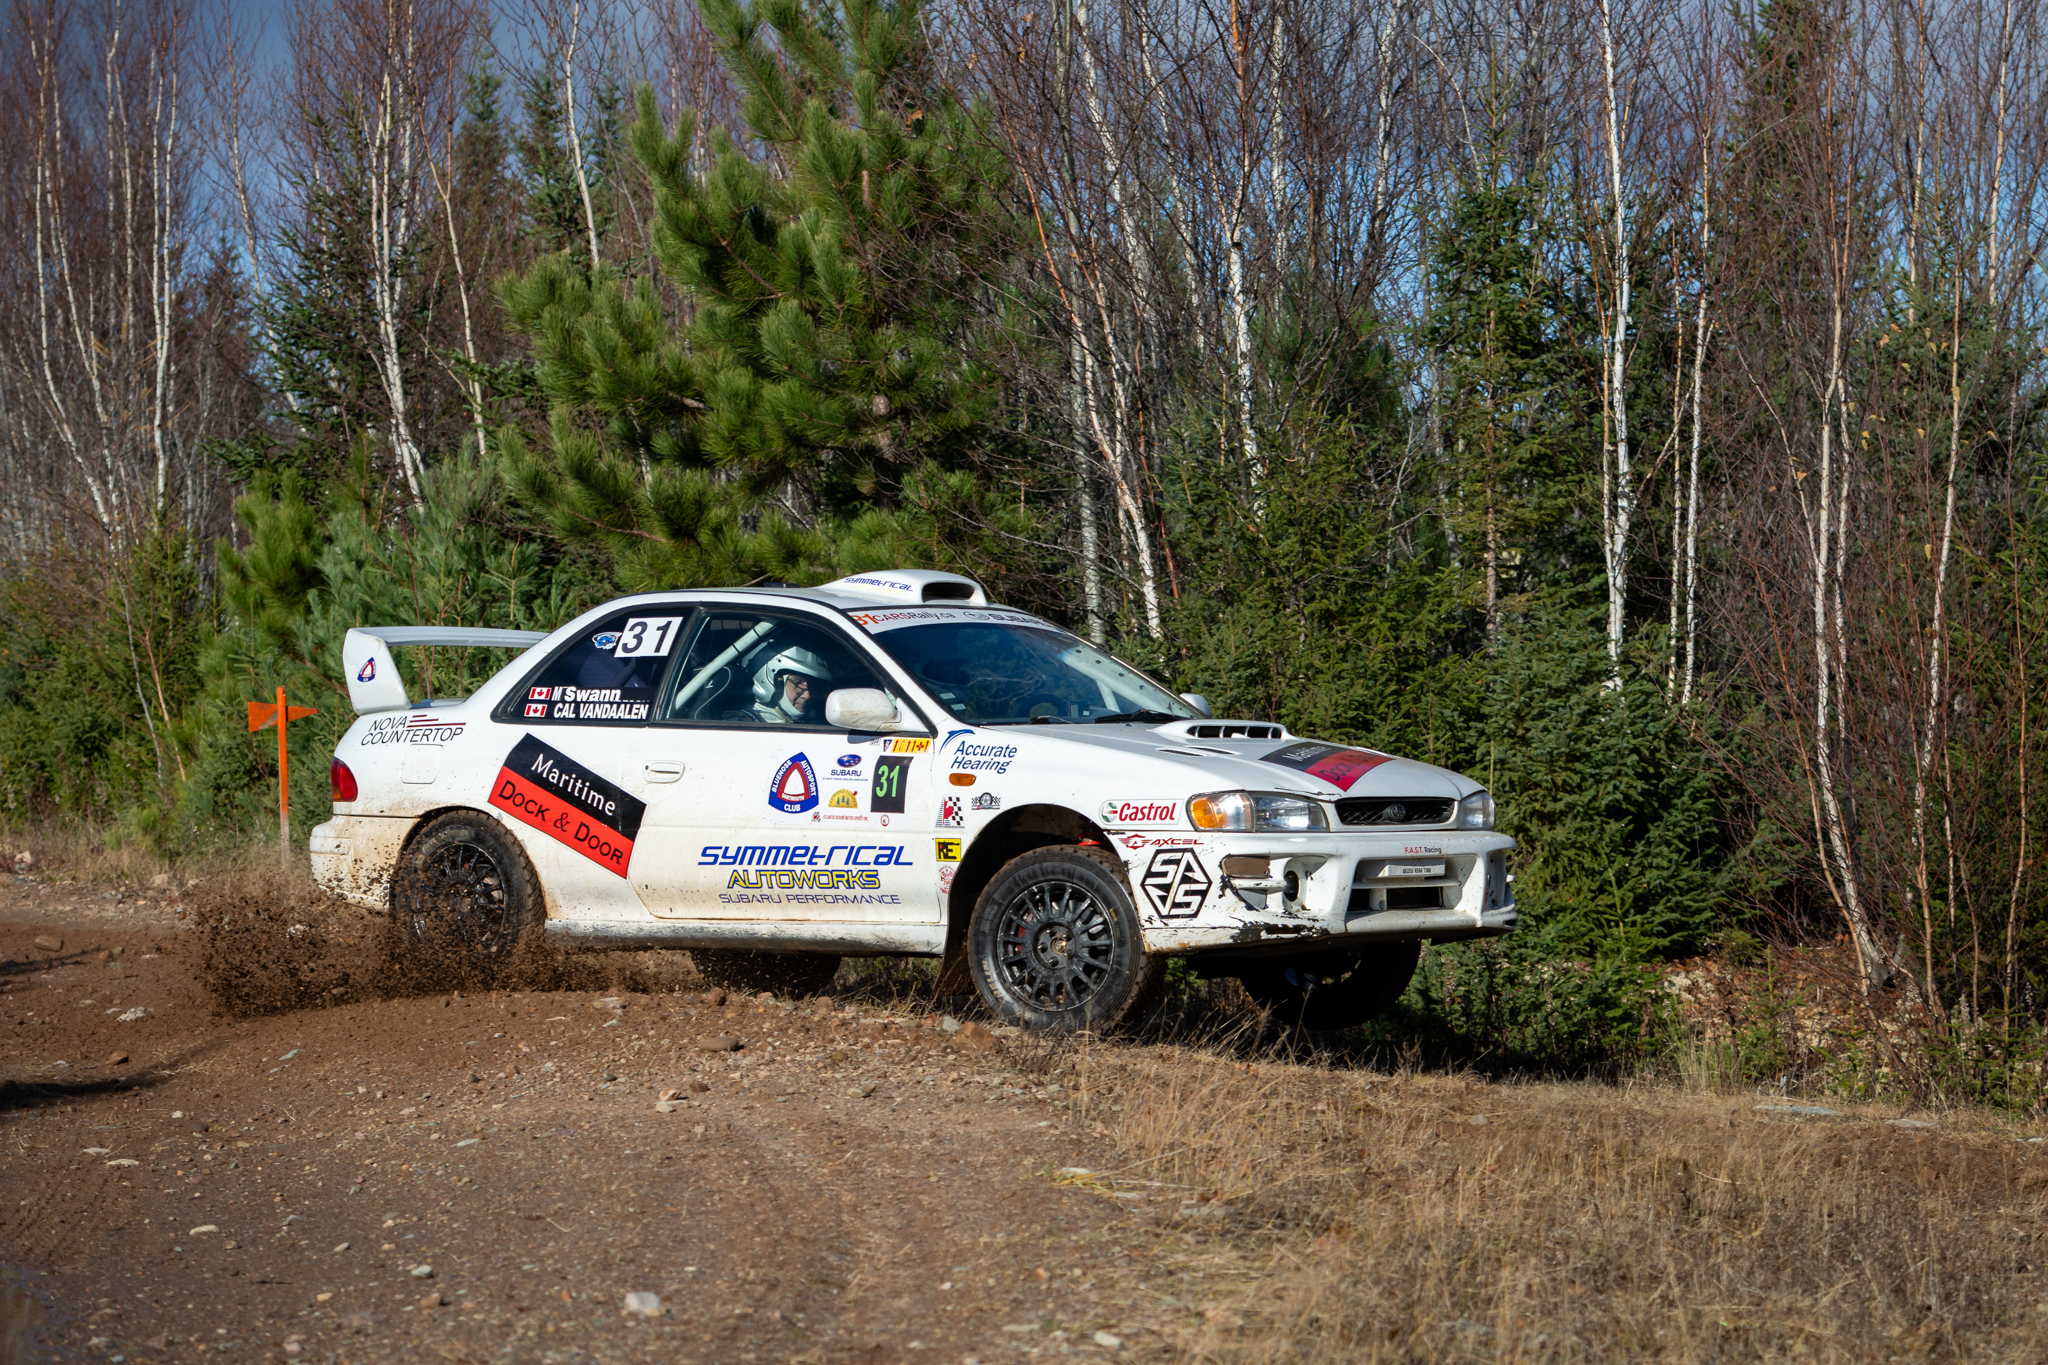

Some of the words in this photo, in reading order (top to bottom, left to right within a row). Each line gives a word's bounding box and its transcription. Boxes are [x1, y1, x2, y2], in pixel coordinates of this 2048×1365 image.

[621, 620, 673, 654] 31
[564, 686, 622, 702] Swann
[553, 702, 577, 719] CAL
[579, 703, 650, 720] VANDAALEN
[368, 715, 408, 733] NOVA
[360, 727, 464, 746] COUNTERTOP
[953, 740, 1018, 759] Accurate
[830, 768, 862, 777] SUBARU
[950, 756, 1013, 775] Hearing
[530, 753, 616, 817] Maritime
[771, 759, 793, 794] BLUENOSE
[800, 759, 817, 796] AUTOSPORT
[875, 764, 900, 798] 31
[783, 803, 802, 812] CLUB
[1118, 802, 1177, 822] Castrol
[553, 811, 571, 833] &
[1424, 845, 1442, 855] Racing
[727, 869, 881, 890] AUTOWORKS
[718, 893, 783, 904] SUBARU
[785, 894, 902, 905] PERFORMANCE
